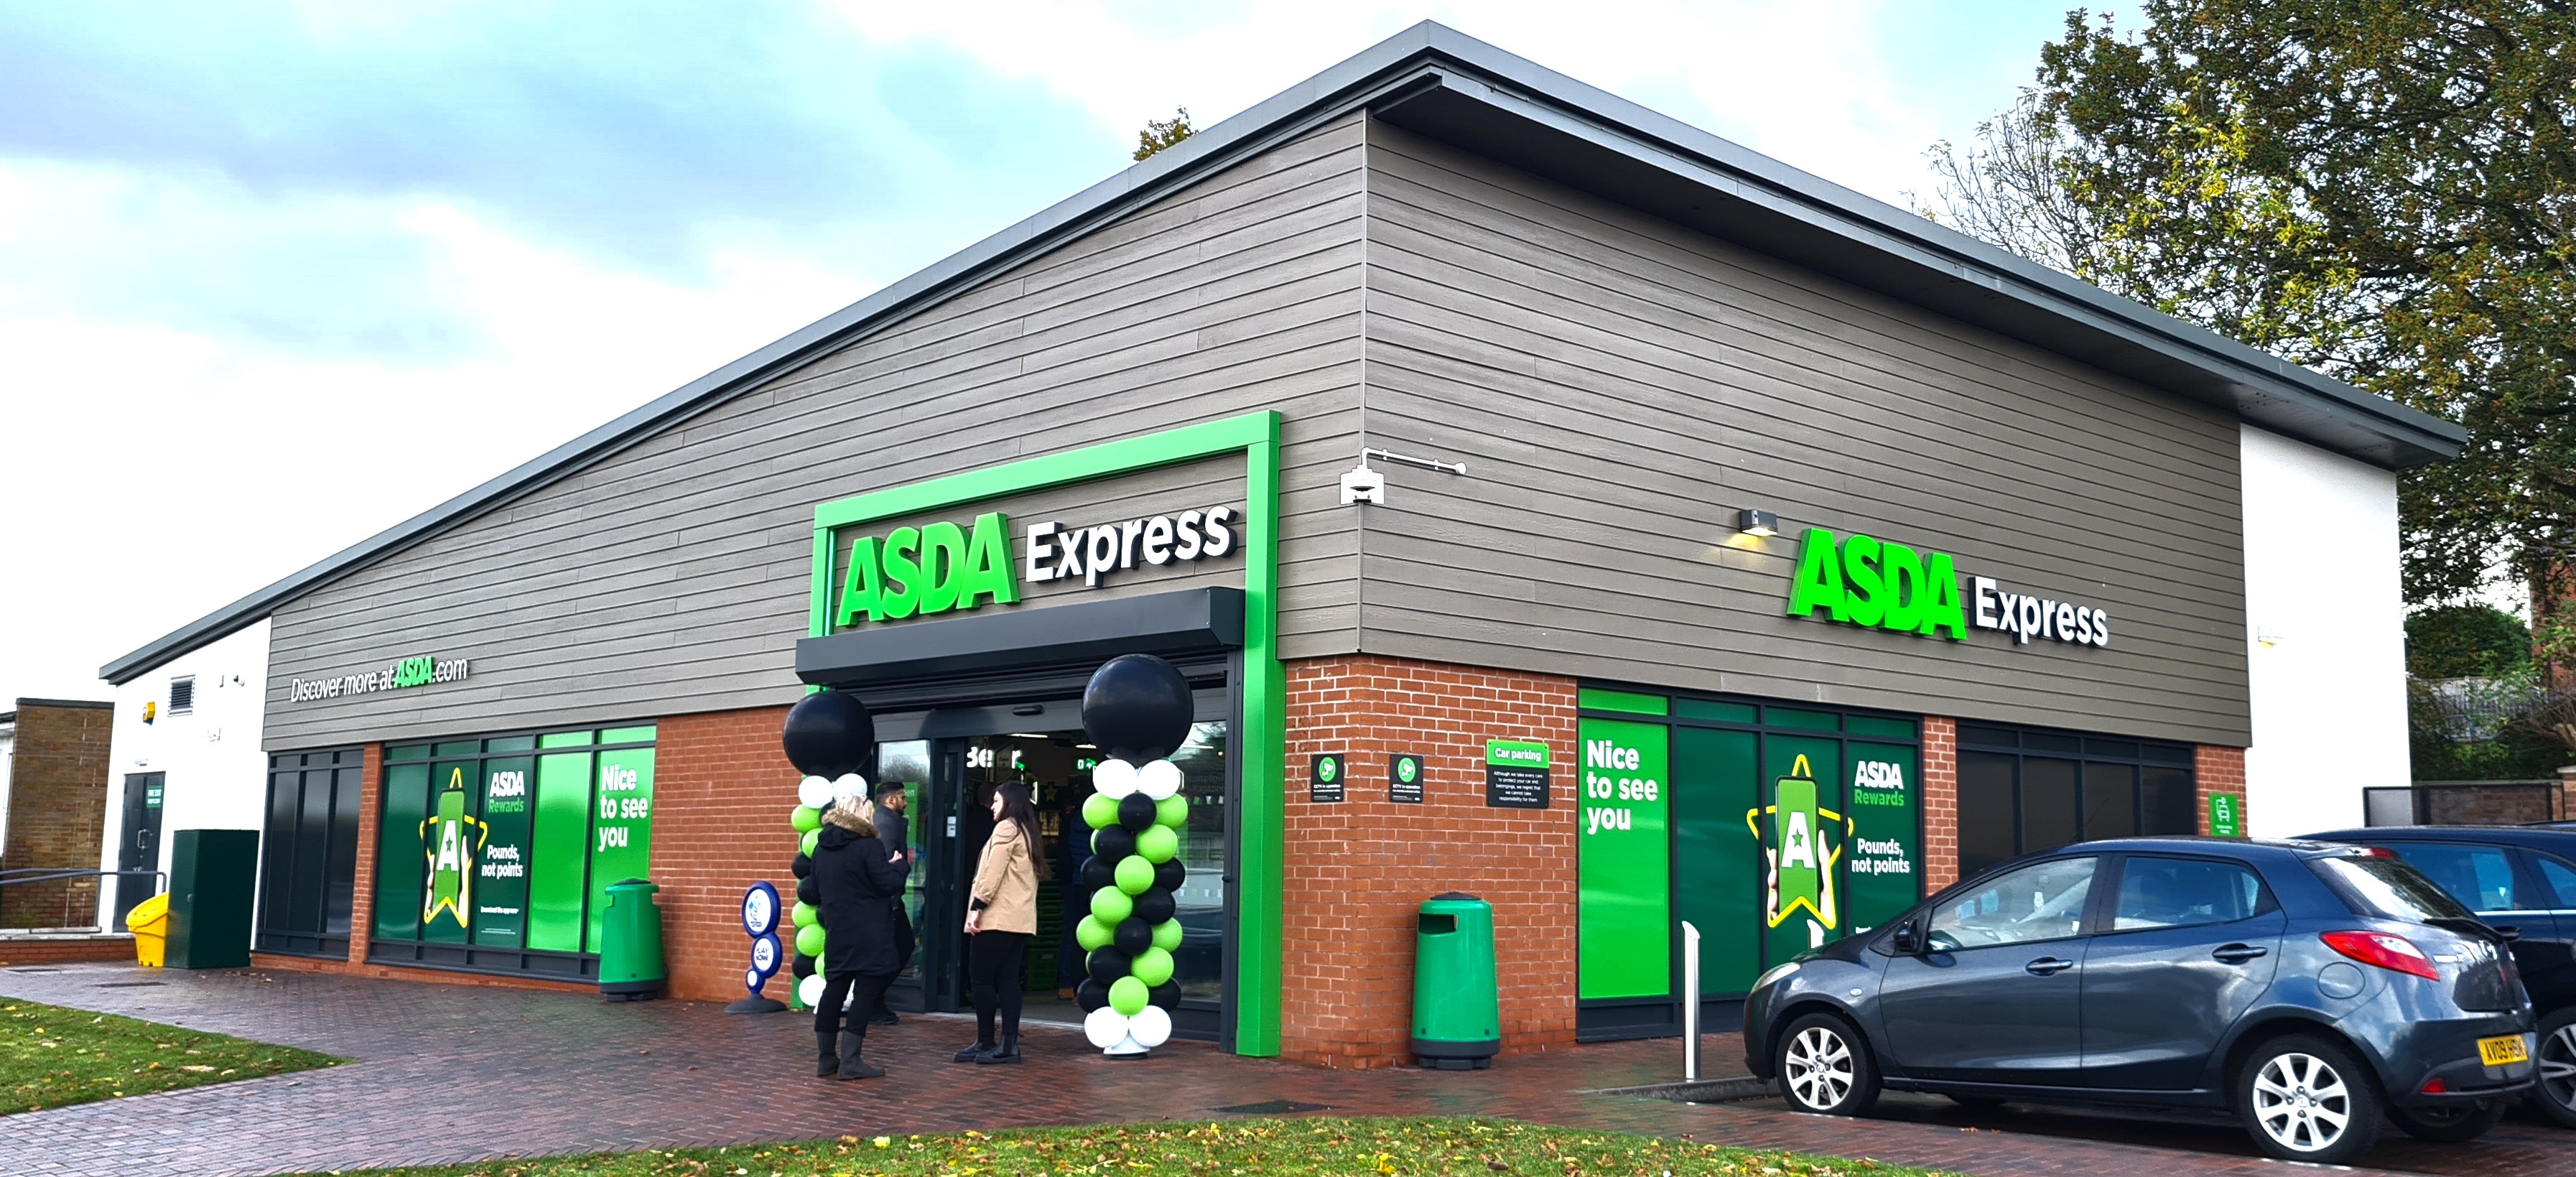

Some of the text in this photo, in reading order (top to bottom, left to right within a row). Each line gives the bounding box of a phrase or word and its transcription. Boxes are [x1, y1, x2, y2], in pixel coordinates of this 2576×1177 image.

[836, 506, 1233, 627] ASDA Express
[1787, 528, 2108, 646] ASDA Express
[290, 655, 468, 702] Discover more at ASDA.com
[966, 746, 1021, 769] Ber
[1494, 747, 1542, 763] Car parking
[1586, 739, 1640, 771] Nice
[489, 771, 525, 797] ASDA
[601, 763, 637, 791] Nice
[1586, 771, 1658, 801] to see
[1854, 760, 1904, 789] ASDA
[488, 797, 524, 813] Rewards
[600, 794, 648, 819] to see
[1854, 788, 1904, 806] Rewards
[1586, 806, 1631, 835] you
[597, 827, 628, 852] you
[1857, 837, 1904, 857] Pounds,
[487, 844, 520, 862] Pounds,
[481, 861, 524, 880] not points
[1851, 857, 1910, 876] not points
